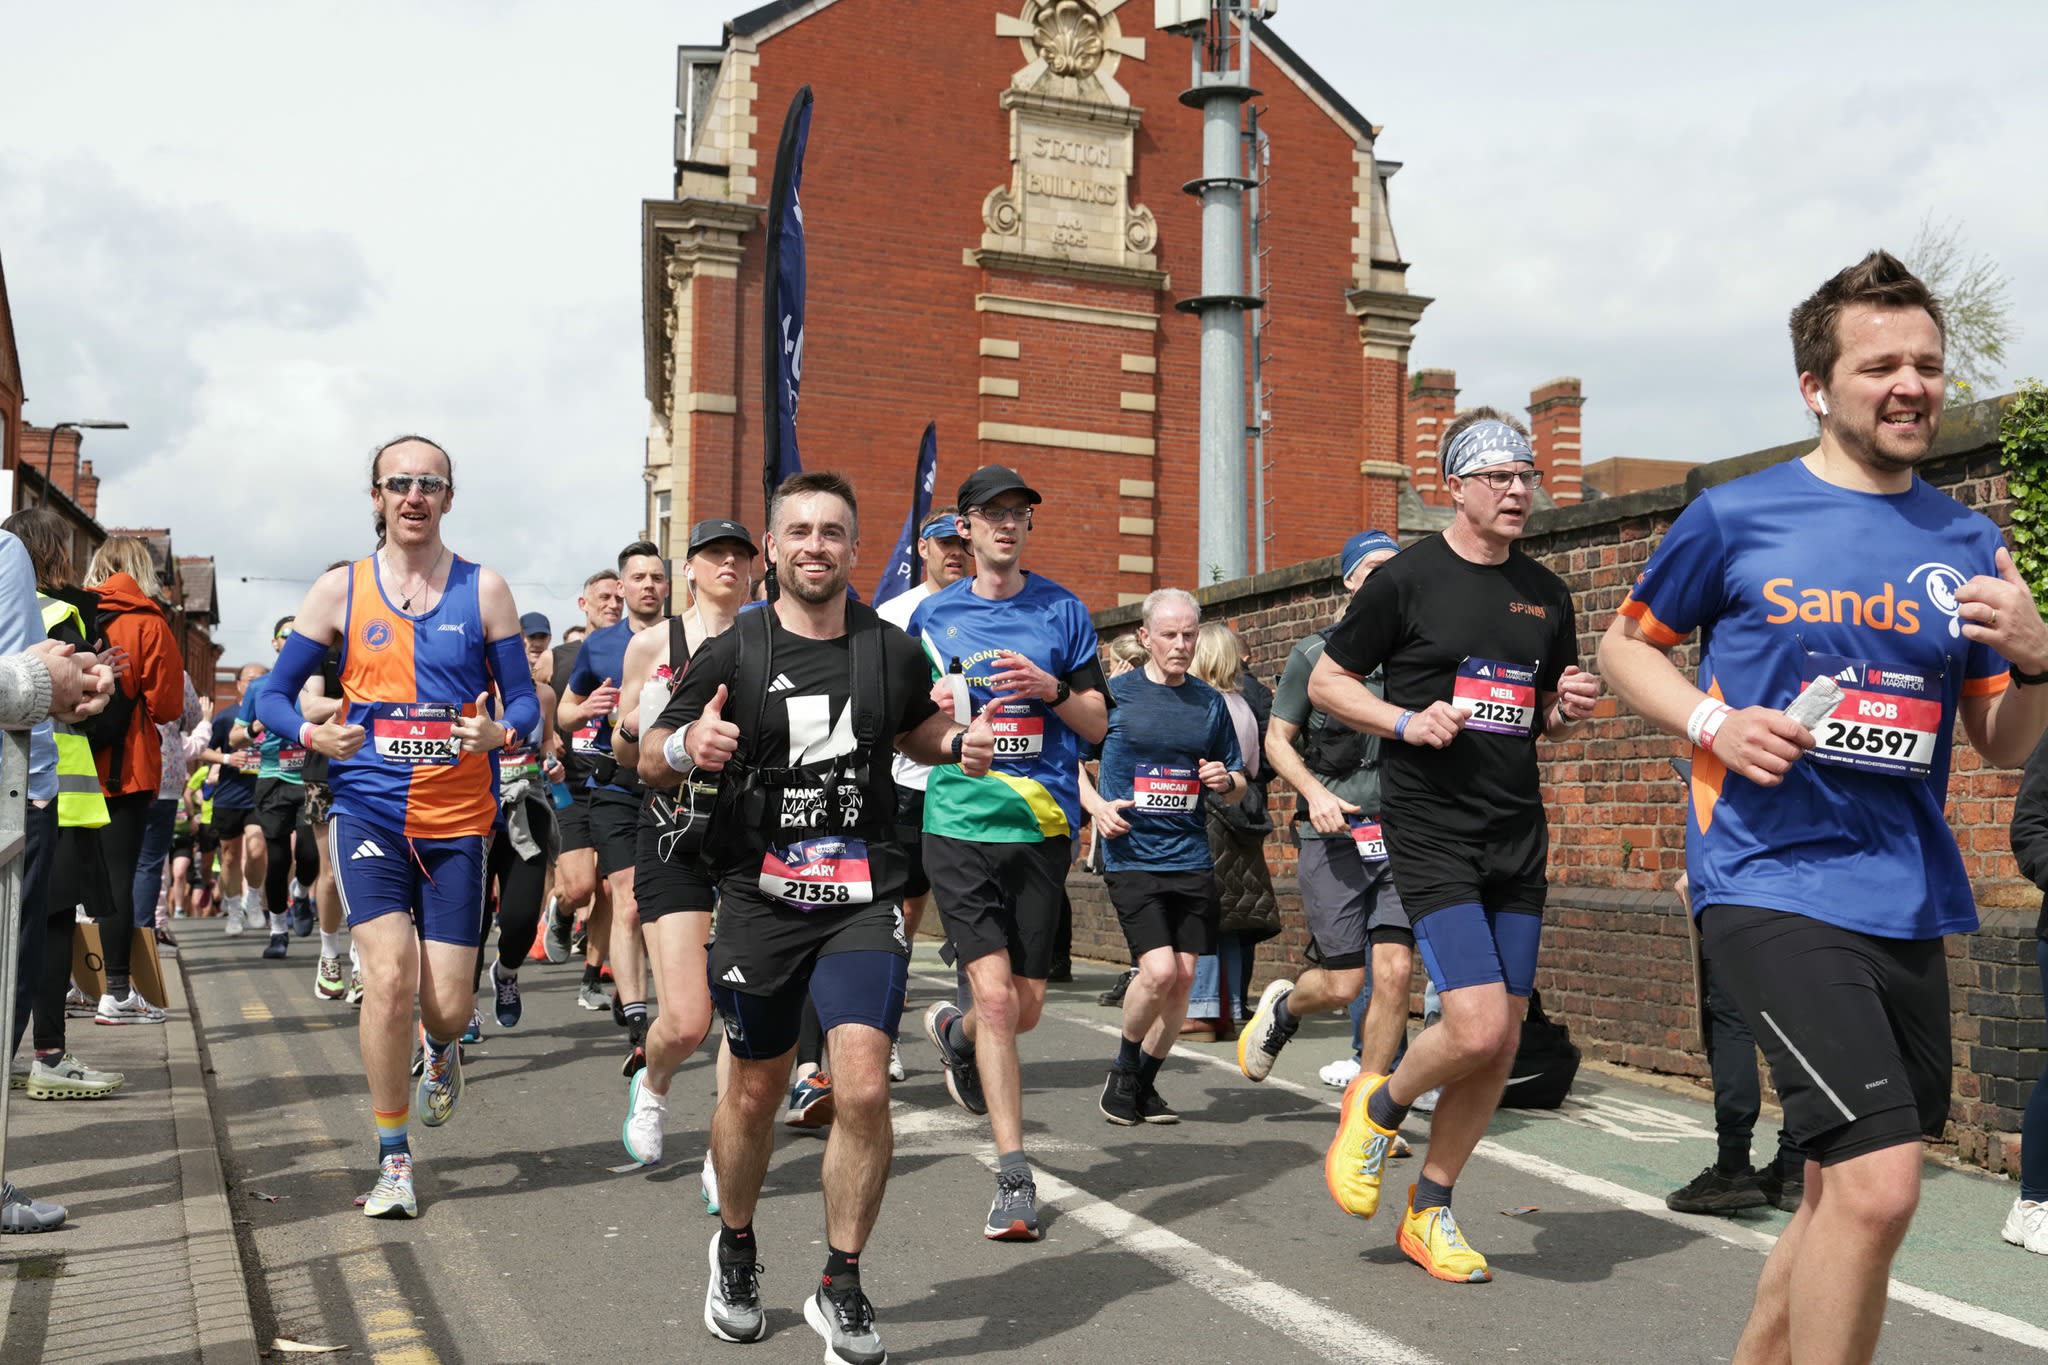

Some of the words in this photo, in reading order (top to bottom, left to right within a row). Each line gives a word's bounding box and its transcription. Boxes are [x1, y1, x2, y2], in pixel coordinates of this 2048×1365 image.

[1032, 138, 1112, 169] STATION
[1026, 174, 1118, 207] BUILDINGS
[1762, 578, 1921, 635] Sands
[1881, 677, 1925, 691] MARATHON
[1882, 671, 1924, 684] MANCHESTER
[1490, 687, 1516, 700] NEIL
[1474, 702, 1524, 725] 21232
[1858, 699, 1898, 719] ROB
[409, 726, 426, 735] AJ
[992, 723, 1018, 732] MIKE
[1825, 722, 1918, 758] 26597
[388, 740, 445, 755] 45382
[1150, 782, 1188, 792] DUNCAN
[1147, 795, 1188, 808] 26204
[1368, 841, 1383, 853] 27
[783, 881, 850, 903] 21358
